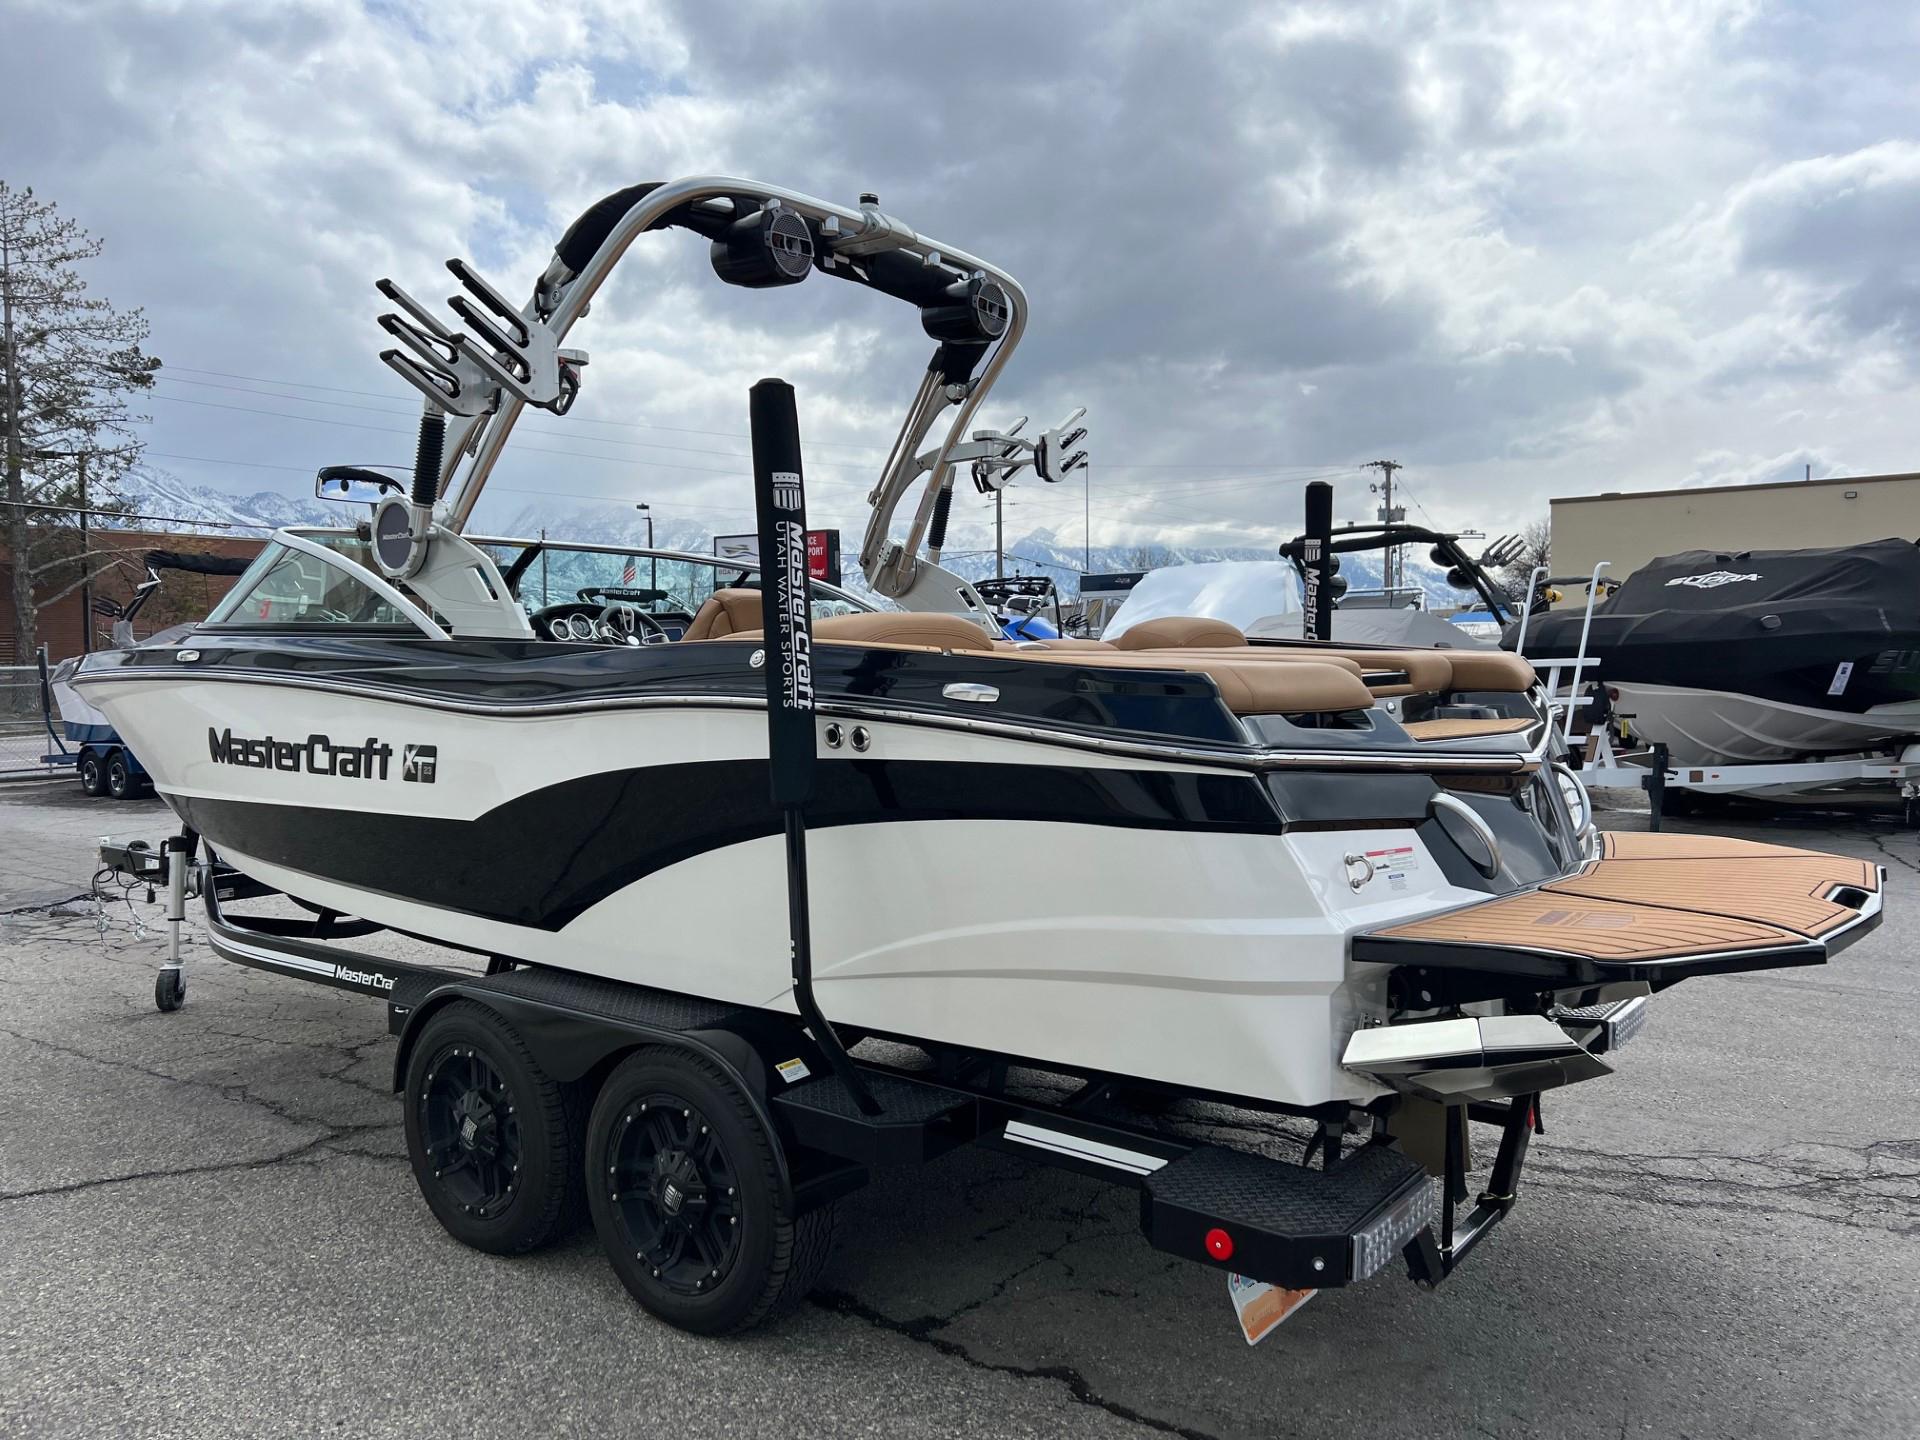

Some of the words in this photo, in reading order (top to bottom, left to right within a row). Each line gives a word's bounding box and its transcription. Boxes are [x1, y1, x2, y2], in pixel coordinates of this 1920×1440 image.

[775, 521, 787, 569] UTAH
[777, 577, 790, 634] WATER
[789, 521, 813, 710] MasterCraft
[780, 643, 794, 708] SPORTS
[208, 727, 393, 780] MasterCraft
